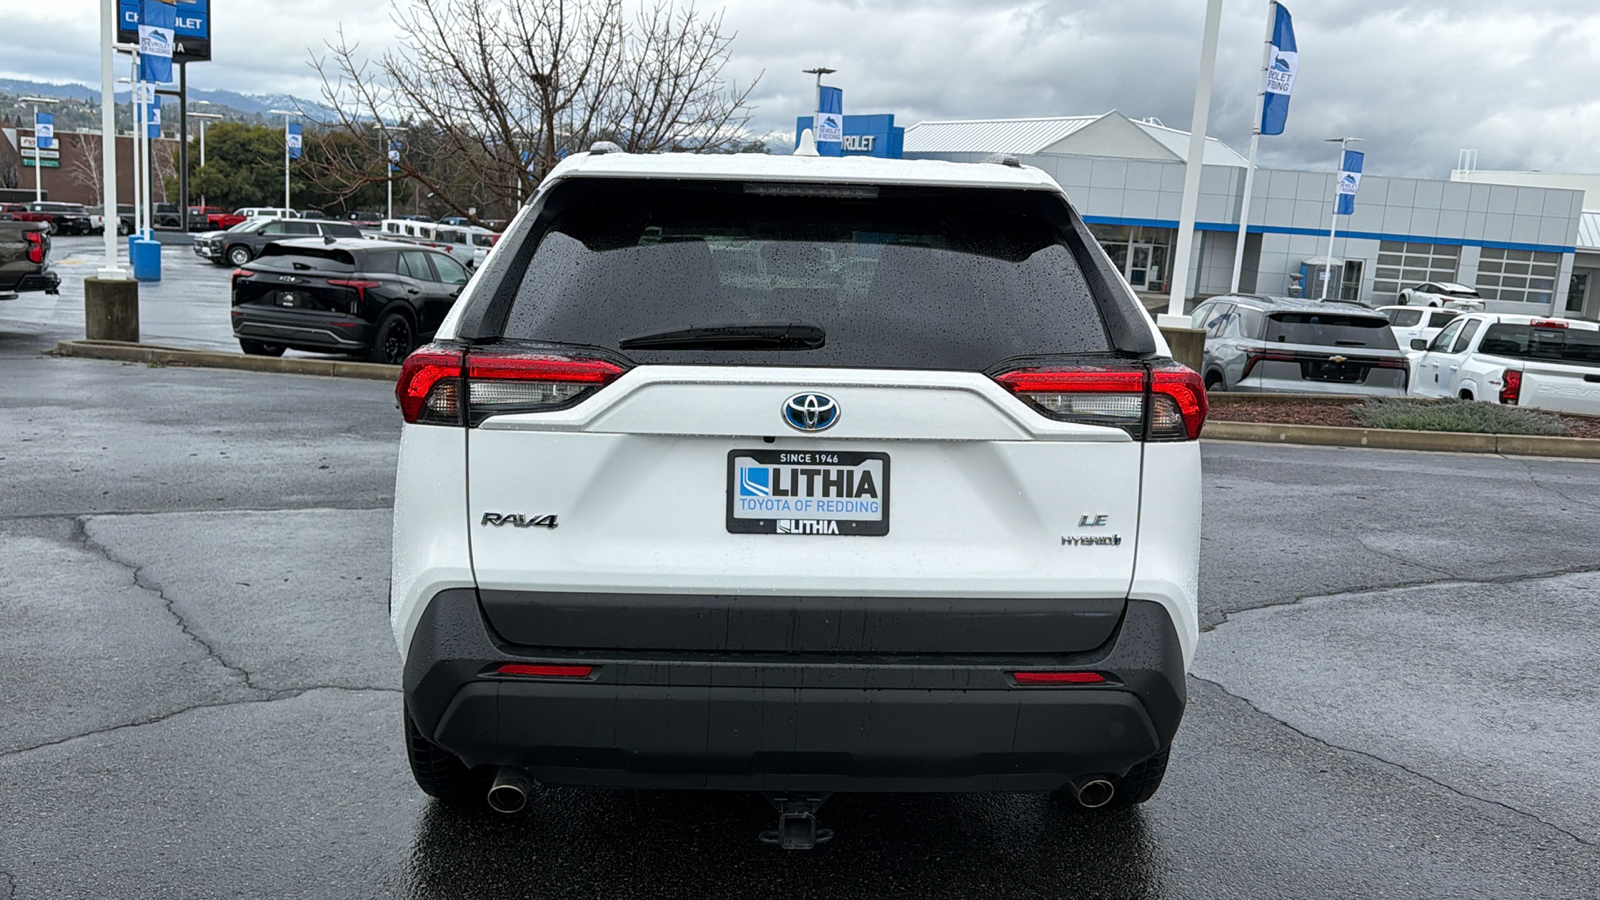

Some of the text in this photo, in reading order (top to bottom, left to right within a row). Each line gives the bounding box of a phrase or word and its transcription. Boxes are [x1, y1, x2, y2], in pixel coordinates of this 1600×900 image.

[125, 11, 202, 30] CHLET
[842, 136, 874, 151] ROLET
[780, 453, 839, 463] SINCE 1946
[772, 468, 878, 498] LITHIA
[739, 498, 879, 513] TOYOTA OF REDDING
[481, 512, 558, 530] RAV4
[790, 519, 839, 534] LITHIA
[1078, 514, 1109, 528] LE
[1061, 534, 1114, 547] HYBRID
